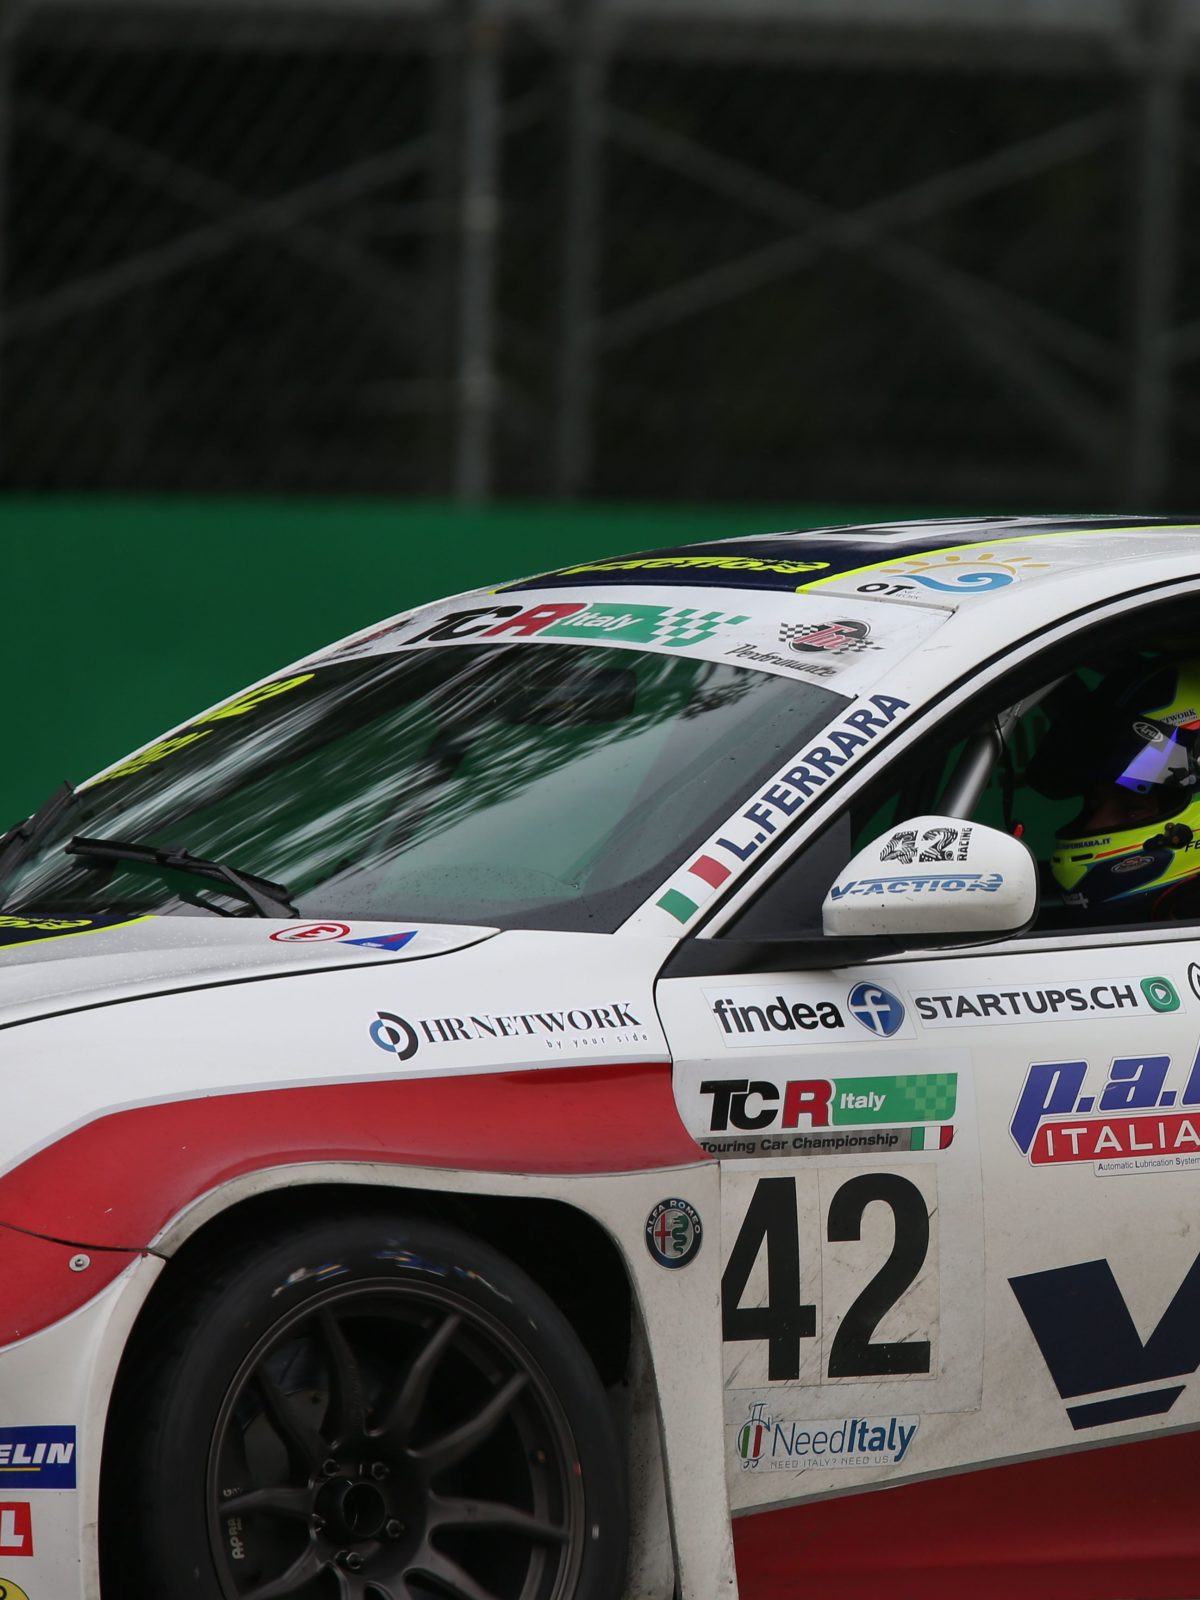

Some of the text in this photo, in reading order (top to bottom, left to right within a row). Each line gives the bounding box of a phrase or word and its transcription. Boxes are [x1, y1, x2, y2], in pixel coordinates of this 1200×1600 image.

[398, 602, 588, 647] TCR
[562, 611, 644, 632] Italy
[724, 642, 837, 678] Performance
[715, 693, 909, 862] L.FERRARA
[879, 827, 973, 865] 42 RACING
[712, 996, 845, 1034] findea
[914, 985, 1138, 1020] STARTUPS.CH
[546, 1032, 648, 1050] by your side
[699, 1078, 887, 1132] TCR Italy
[700, 1133, 899, 1154] Touring Car Championship
[1098, 1160, 1134, 1171] Automatic
[1135, 1158, 1174, 1169] Lubrication
[646, 1200, 701, 1235] ALFA ROMEO
[720, 1171, 931, 1382] 42
[770, 1455, 889, 1470] NEED ITALY? NEED US
